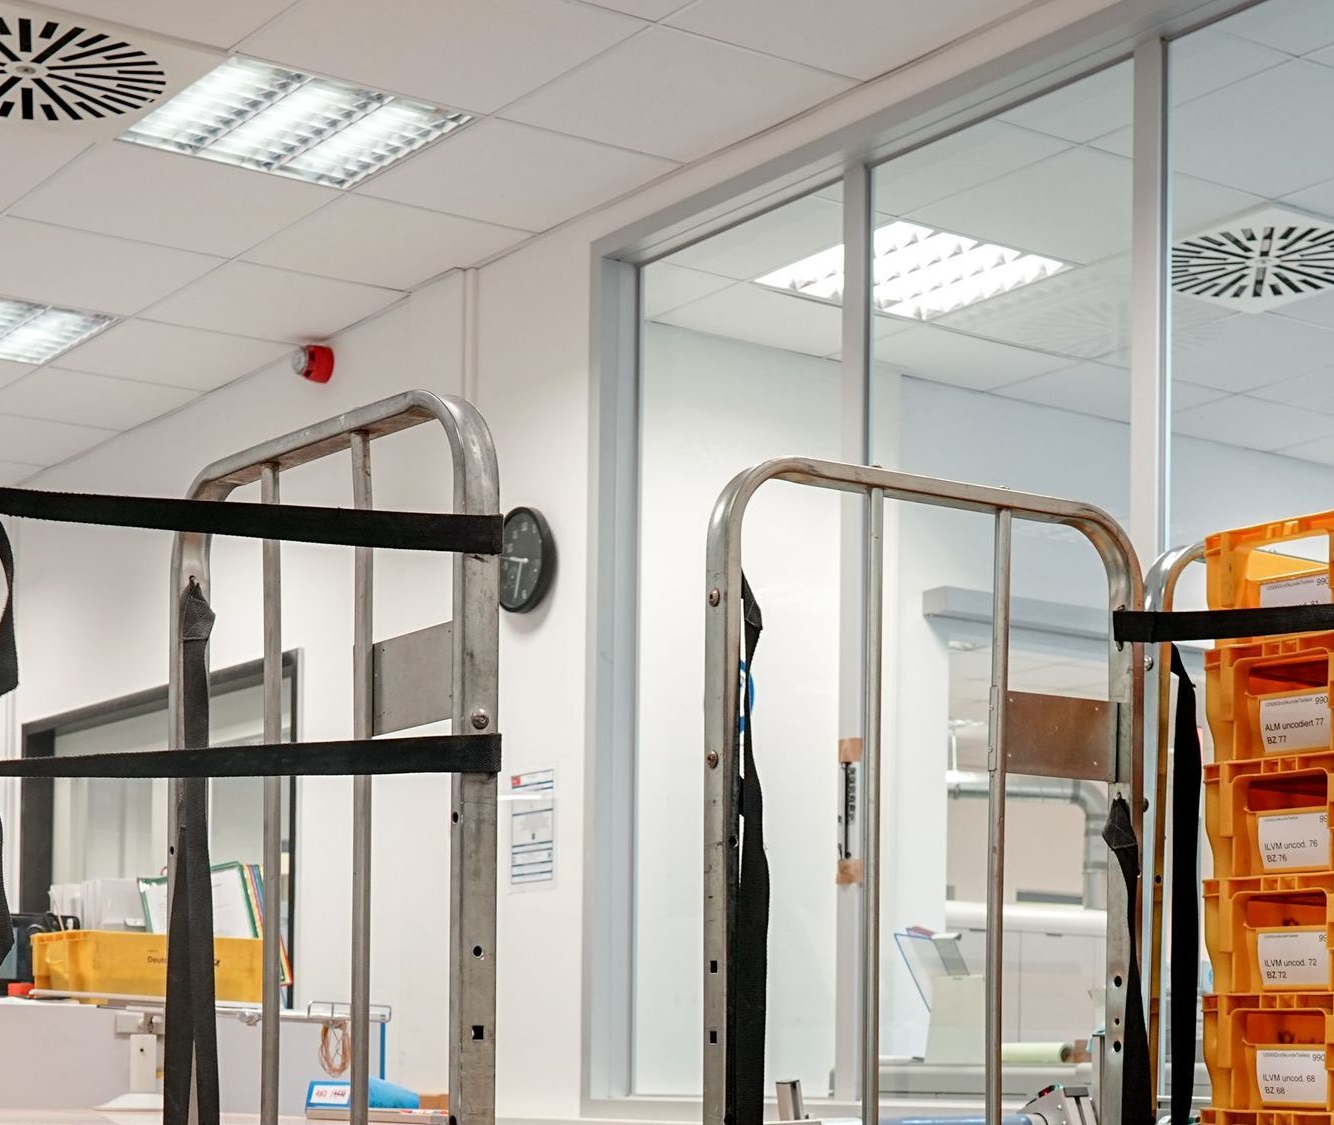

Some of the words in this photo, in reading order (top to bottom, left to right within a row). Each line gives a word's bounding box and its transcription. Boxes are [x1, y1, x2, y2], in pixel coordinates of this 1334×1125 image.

[1315, 696, 1328, 705] 990
[1265, 722, 1281, 732] ALM
[1282, 719, 1314, 730] uncodiert
[1315, 717, 1324, 726] 77
[1267, 736, 1278, 745] BZ
[1278, 735, 1287, 743] 77
[1264, 842, 1283, 851] ILVM
[1308, 839, 1318, 847] 76
[1266, 854, 1277, 863] BZ
[1277, 854, 1287, 862] 76
[1264, 959, 1283, 967] ILVM
[1308, 958, 1317, 966] 72
[1266, 971, 1277, 979] BZ
[1278, 971, 1287, 979] 72
[1262, 1073, 1281, 1082] ILVM
[1306, 1074, 1316, 1083] 68
[1264, 1086, 1275, 1094] BZ
[1276, 1087, 1285, 1095] 68
